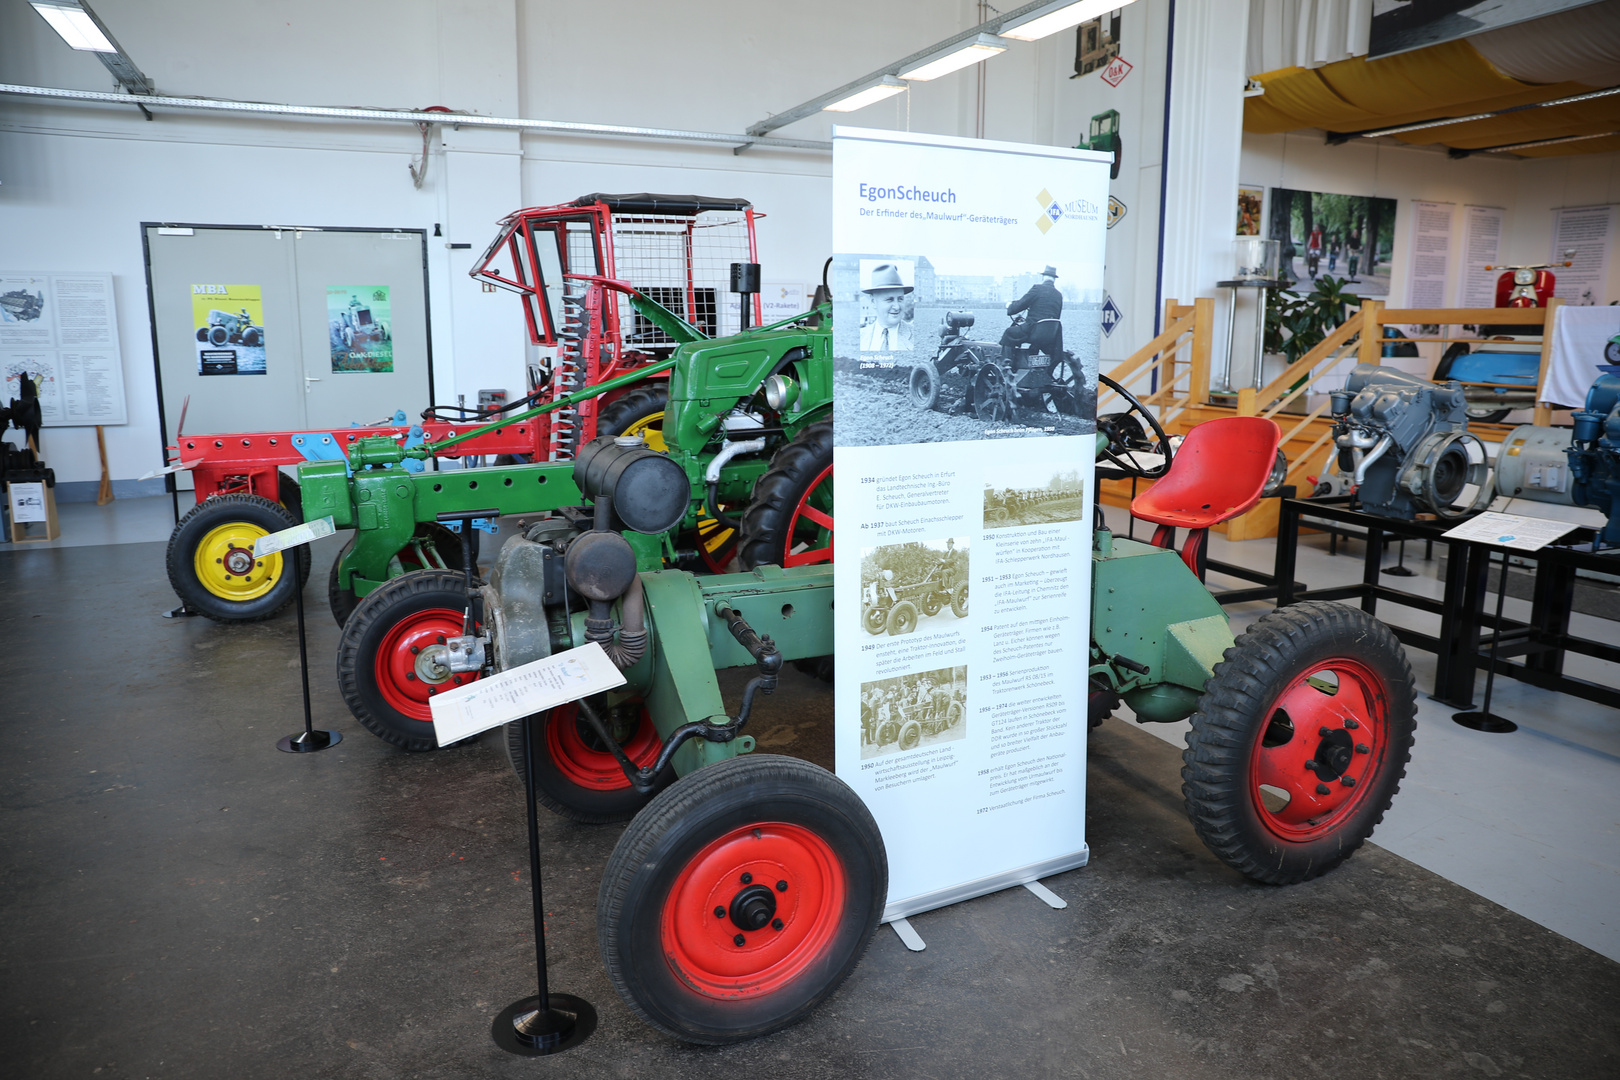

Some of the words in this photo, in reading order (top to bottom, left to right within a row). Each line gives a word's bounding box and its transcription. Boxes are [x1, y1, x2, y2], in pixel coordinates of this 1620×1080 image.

[860, 183, 956, 203] EgonScheuch
[1064, 198, 1098, 214] MUSEUM
[860, 208, 875, 216] Der
[876, 208, 908, 218] Erfinder
[192, 284, 228, 295] MBA
[1102, 310, 1116, 323] IFA
